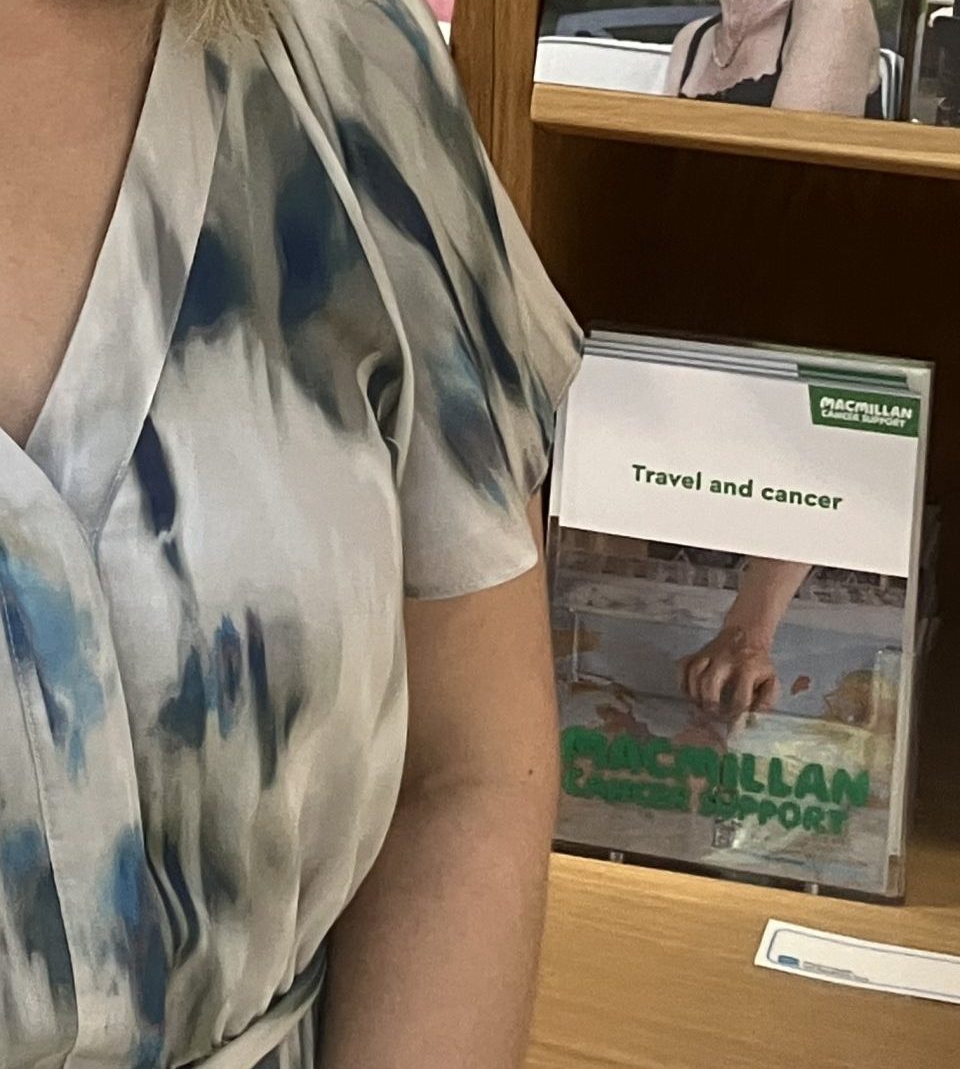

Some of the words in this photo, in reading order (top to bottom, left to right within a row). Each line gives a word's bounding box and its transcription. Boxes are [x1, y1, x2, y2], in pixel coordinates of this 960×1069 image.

[820, 396, 913, 420] MACMILLAN
[631, 463, 702, 492] Travel
[709, 477, 754, 499] and
[761, 486, 844, 511] cancer
[560, 725, 870, 807] MACMILLAN
[698, 786, 850, 836] SUPPORT
